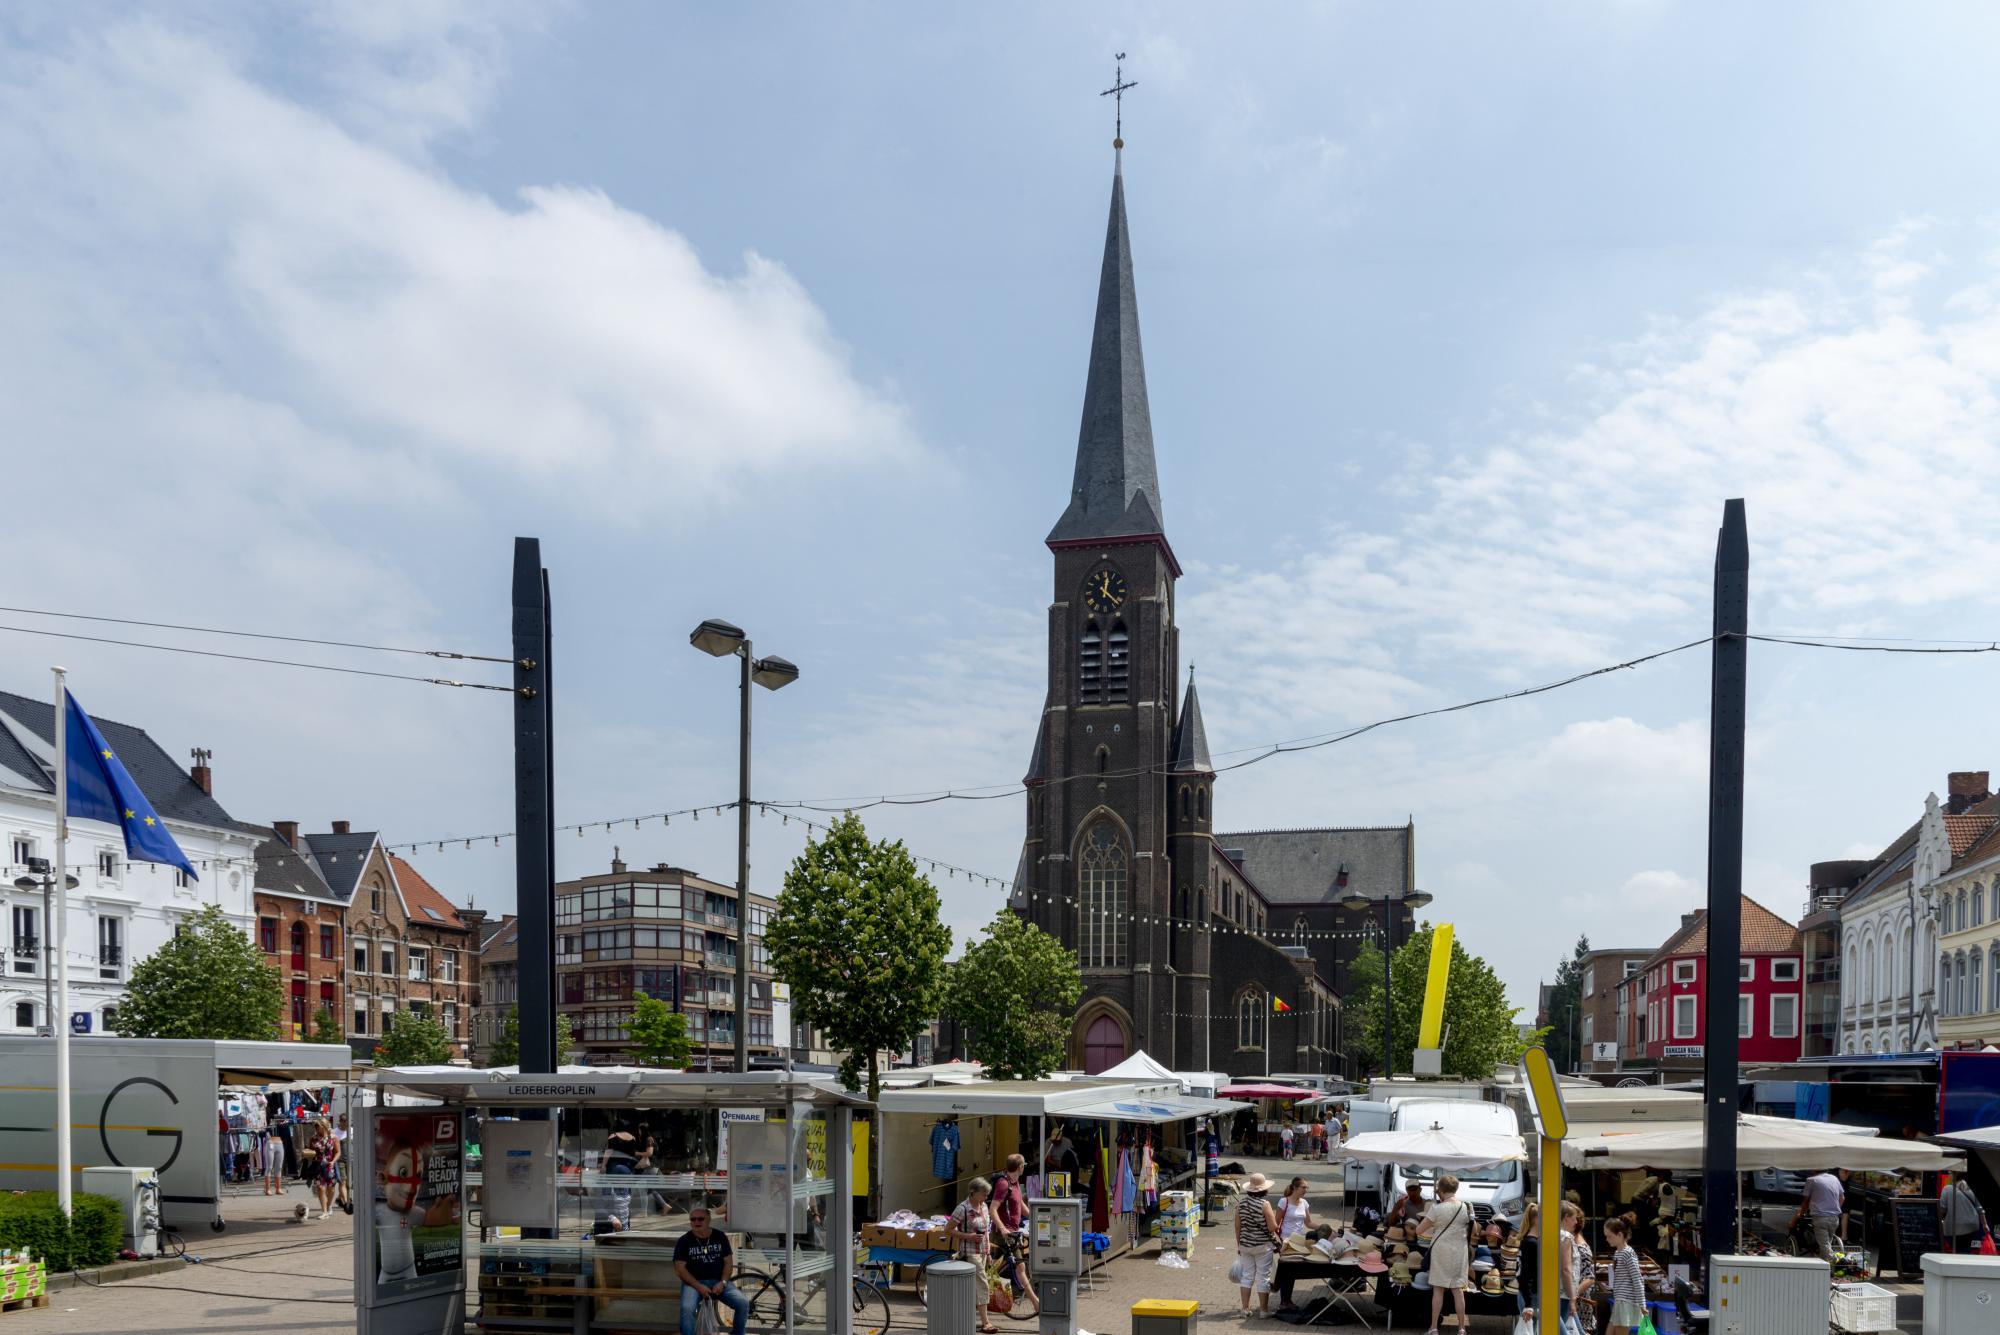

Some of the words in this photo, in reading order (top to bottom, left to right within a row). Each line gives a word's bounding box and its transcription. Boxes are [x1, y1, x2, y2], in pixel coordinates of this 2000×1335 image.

[508, 1085, 596, 1095] LEDEBERGPLEIN
[428, 1155, 447, 1169] ARE
[447, 1159, 458, 1168] YOU
[428, 1168, 458, 1183] READY
[428, 1187, 436, 1196] TO
[435, 1182, 459, 1196] WIN?
